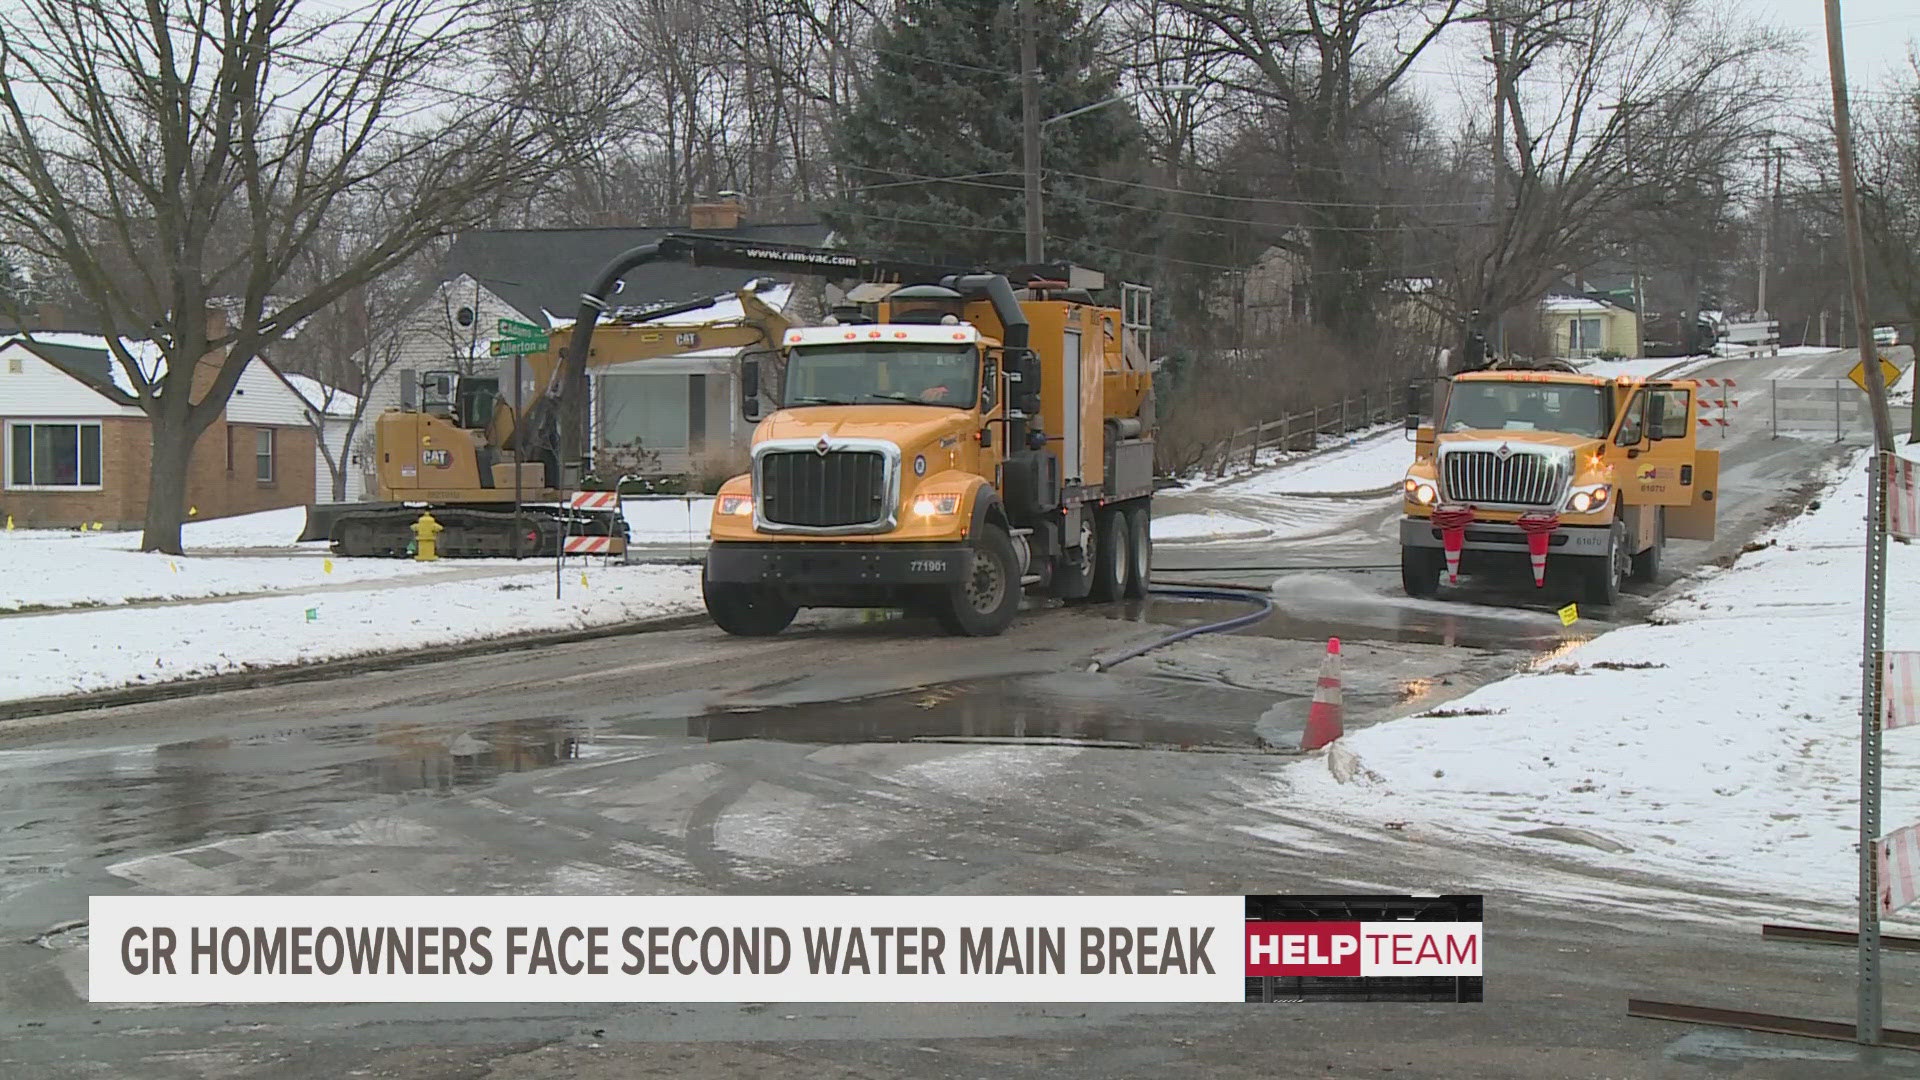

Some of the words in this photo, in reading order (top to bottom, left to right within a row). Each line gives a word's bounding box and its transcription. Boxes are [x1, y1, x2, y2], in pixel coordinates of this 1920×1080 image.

[746, 248, 858, 266] www.ram-vac.com
[676, 332, 696, 346] CAT
[500, 342, 536, 353] Allerton
[423, 449, 448, 465] CAT
[910, 560, 946, 572] 771901
